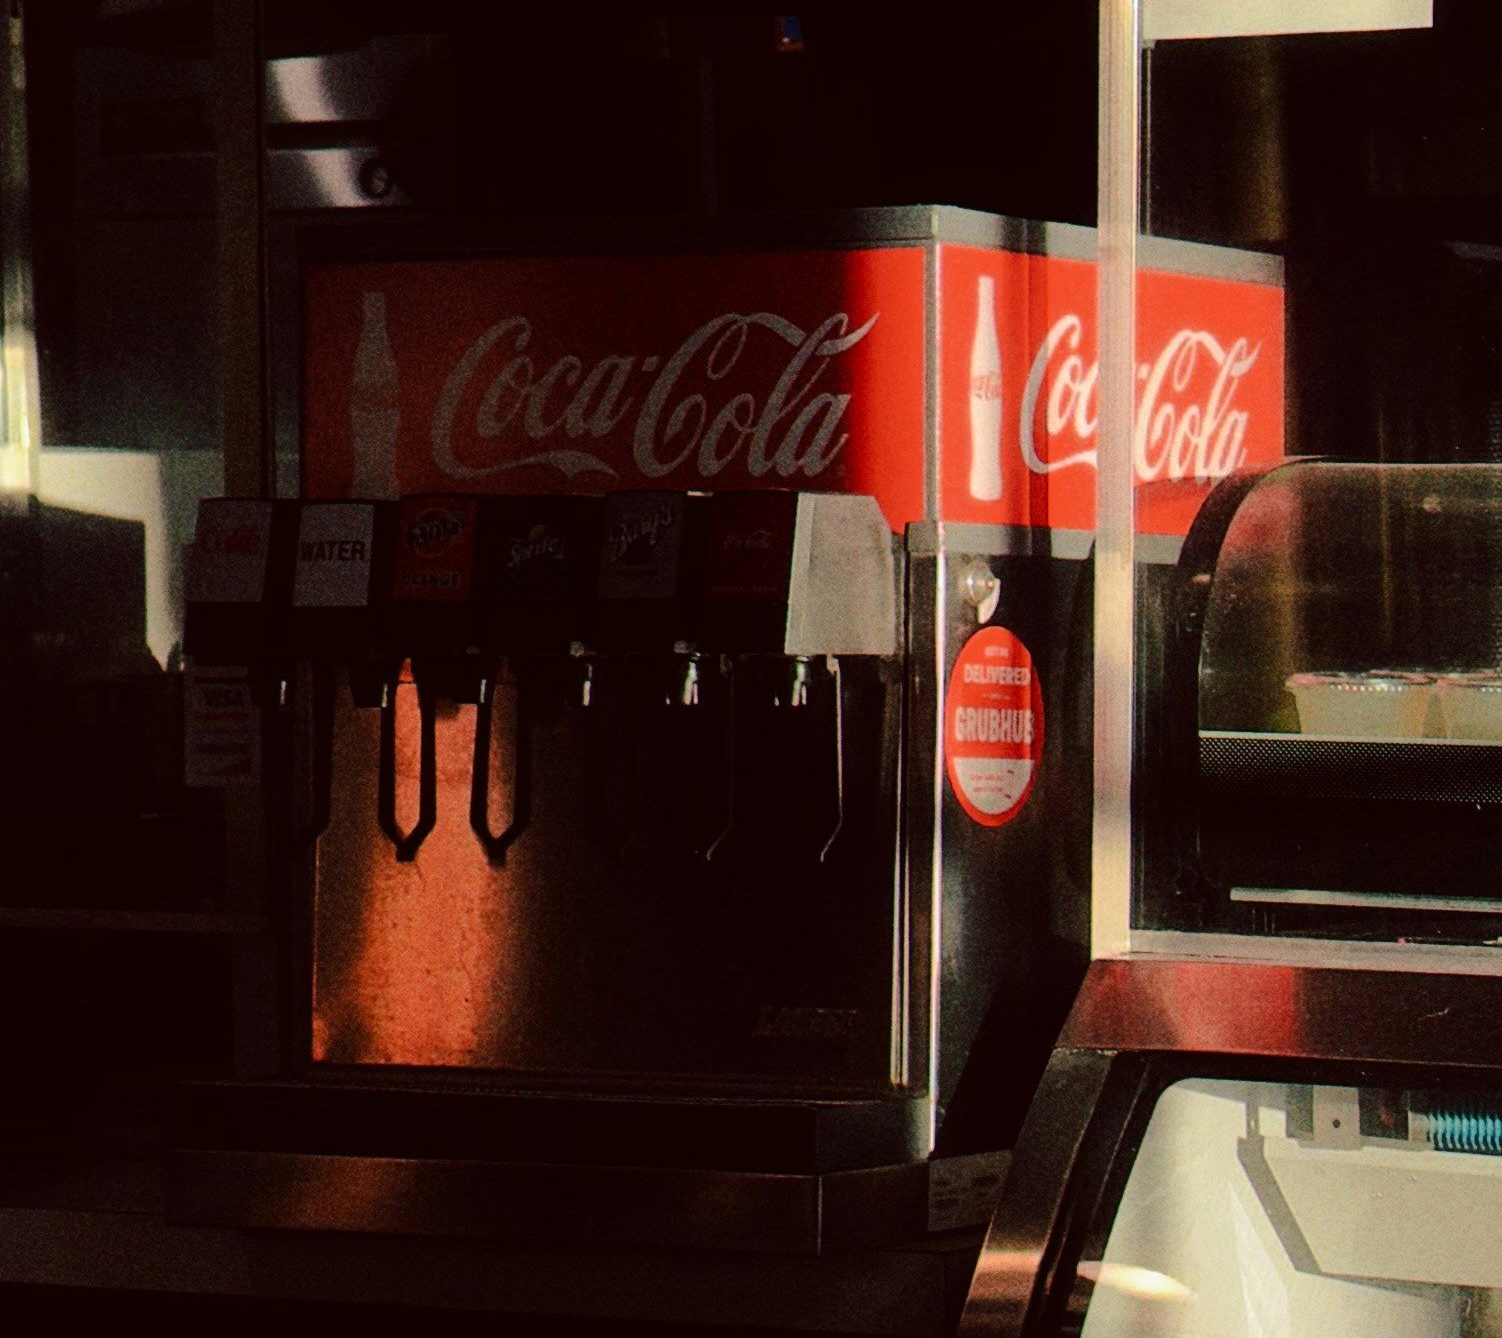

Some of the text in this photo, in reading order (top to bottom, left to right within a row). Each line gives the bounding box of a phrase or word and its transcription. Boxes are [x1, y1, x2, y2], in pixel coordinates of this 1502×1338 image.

[430, 309, 880, 483] Coca-Cola
[300, 539, 366, 562] WATER
[963, 663, 1031, 687] DELIVERED
[955, 707, 1035, 744] GRUBHUB
